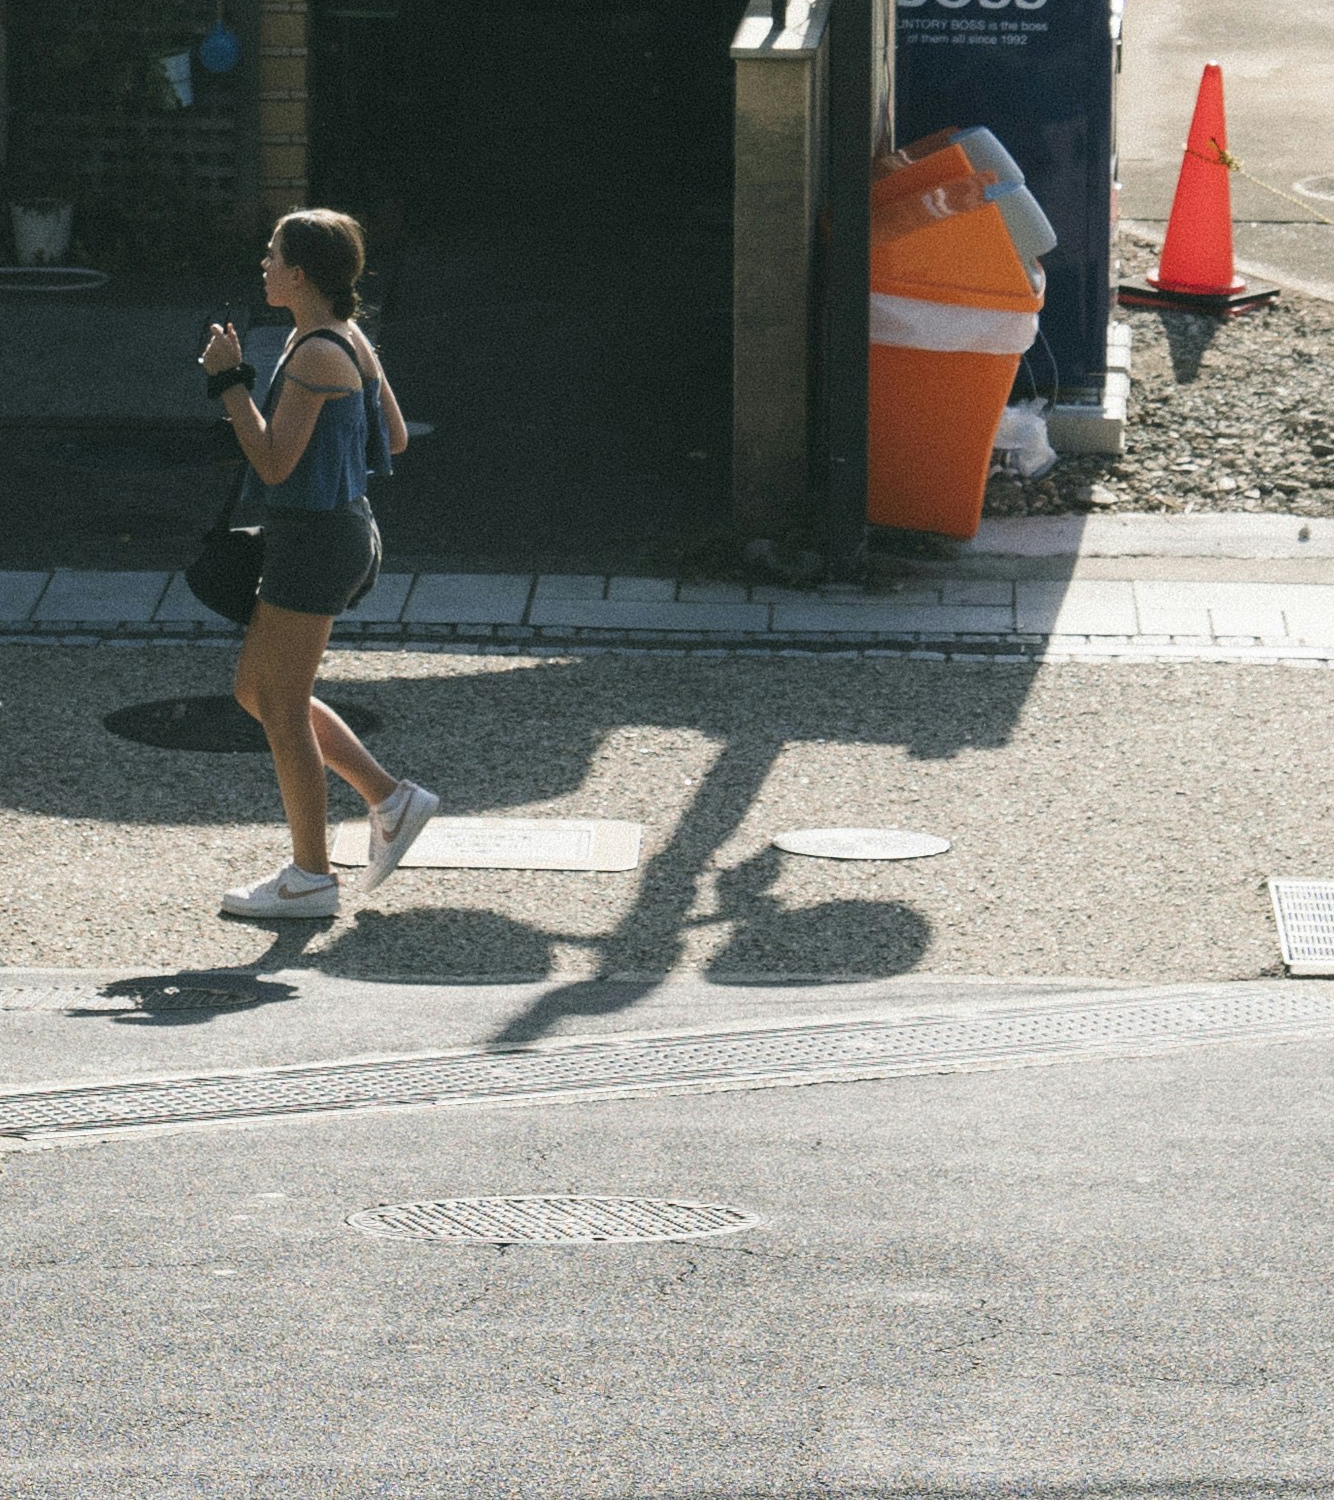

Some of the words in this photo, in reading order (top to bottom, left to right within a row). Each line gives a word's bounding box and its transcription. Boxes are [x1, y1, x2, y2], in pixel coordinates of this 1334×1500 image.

[897, 18, 947, 30] UNTORY
[950, 18, 986, 31] BOSS
[988, 19, 998, 31] is
[1000, 20, 1018, 31] the
[1020, 21, 1049, 32] boss
[968, 34, 998, 45] since
[1001, 34, 1029, 46] 1992
